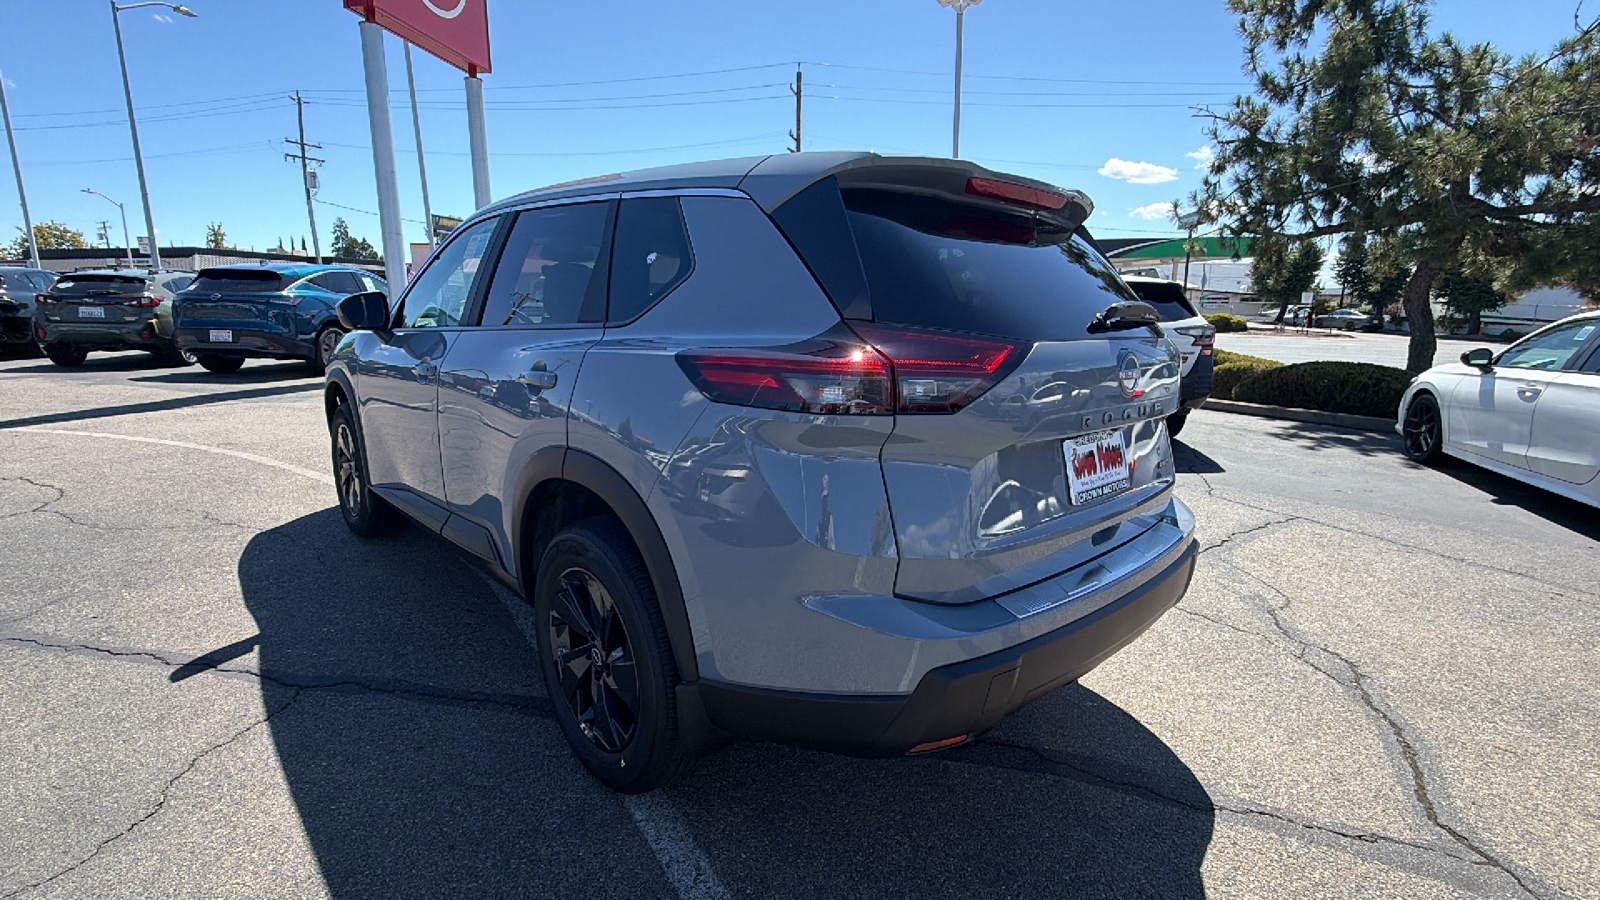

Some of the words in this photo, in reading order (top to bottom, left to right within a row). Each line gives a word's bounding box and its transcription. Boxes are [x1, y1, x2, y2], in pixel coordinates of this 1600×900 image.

[1081, 403, 1163, 430] ROGUE
[1080, 430, 1111, 446] REDDING
[1079, 489, 1102, 503] CROWN
[1103, 480, 1128, 495] MOTORS
